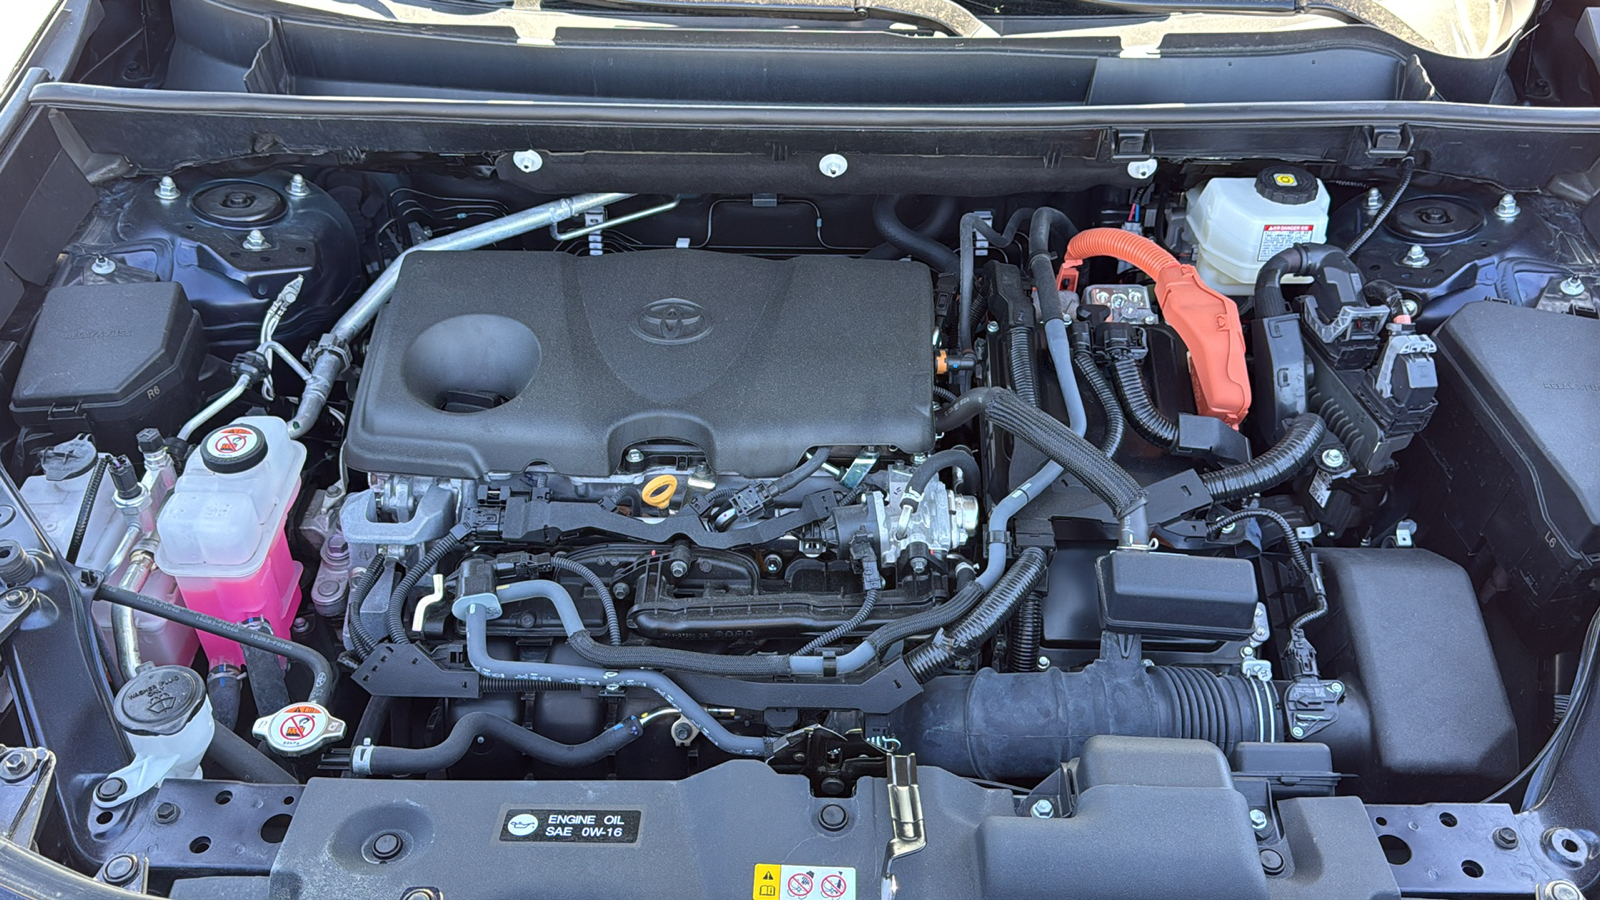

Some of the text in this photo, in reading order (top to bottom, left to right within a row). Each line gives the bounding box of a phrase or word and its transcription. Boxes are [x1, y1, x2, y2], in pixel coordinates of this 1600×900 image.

[1543, 382, 1574, 391] RELAY
[147, 386, 160, 400] R6
[1544, 531, 1557, 548] L6
[547, 814, 625, 825] ENGINE OIL
[545, 826, 623, 838] SAE 0W-16
